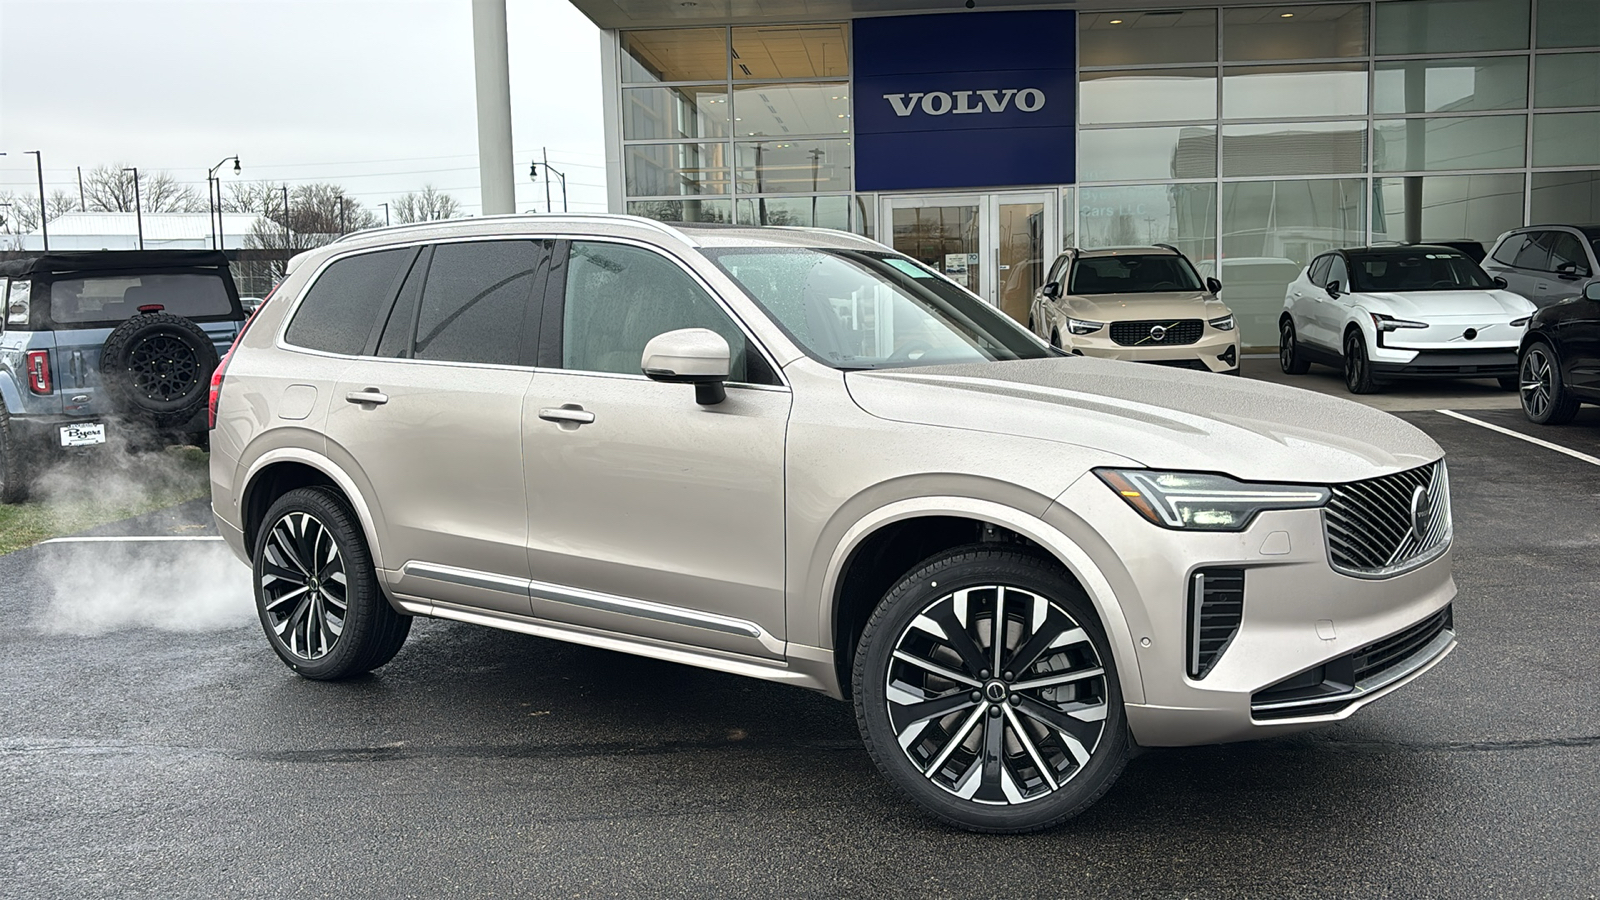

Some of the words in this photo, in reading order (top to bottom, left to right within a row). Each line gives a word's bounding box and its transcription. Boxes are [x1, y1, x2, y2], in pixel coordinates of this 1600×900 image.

[883, 88, 1046, 117] VOLVO
[1080, 205, 1114, 217] Cars
[1119, 203, 1147, 215] LLC
